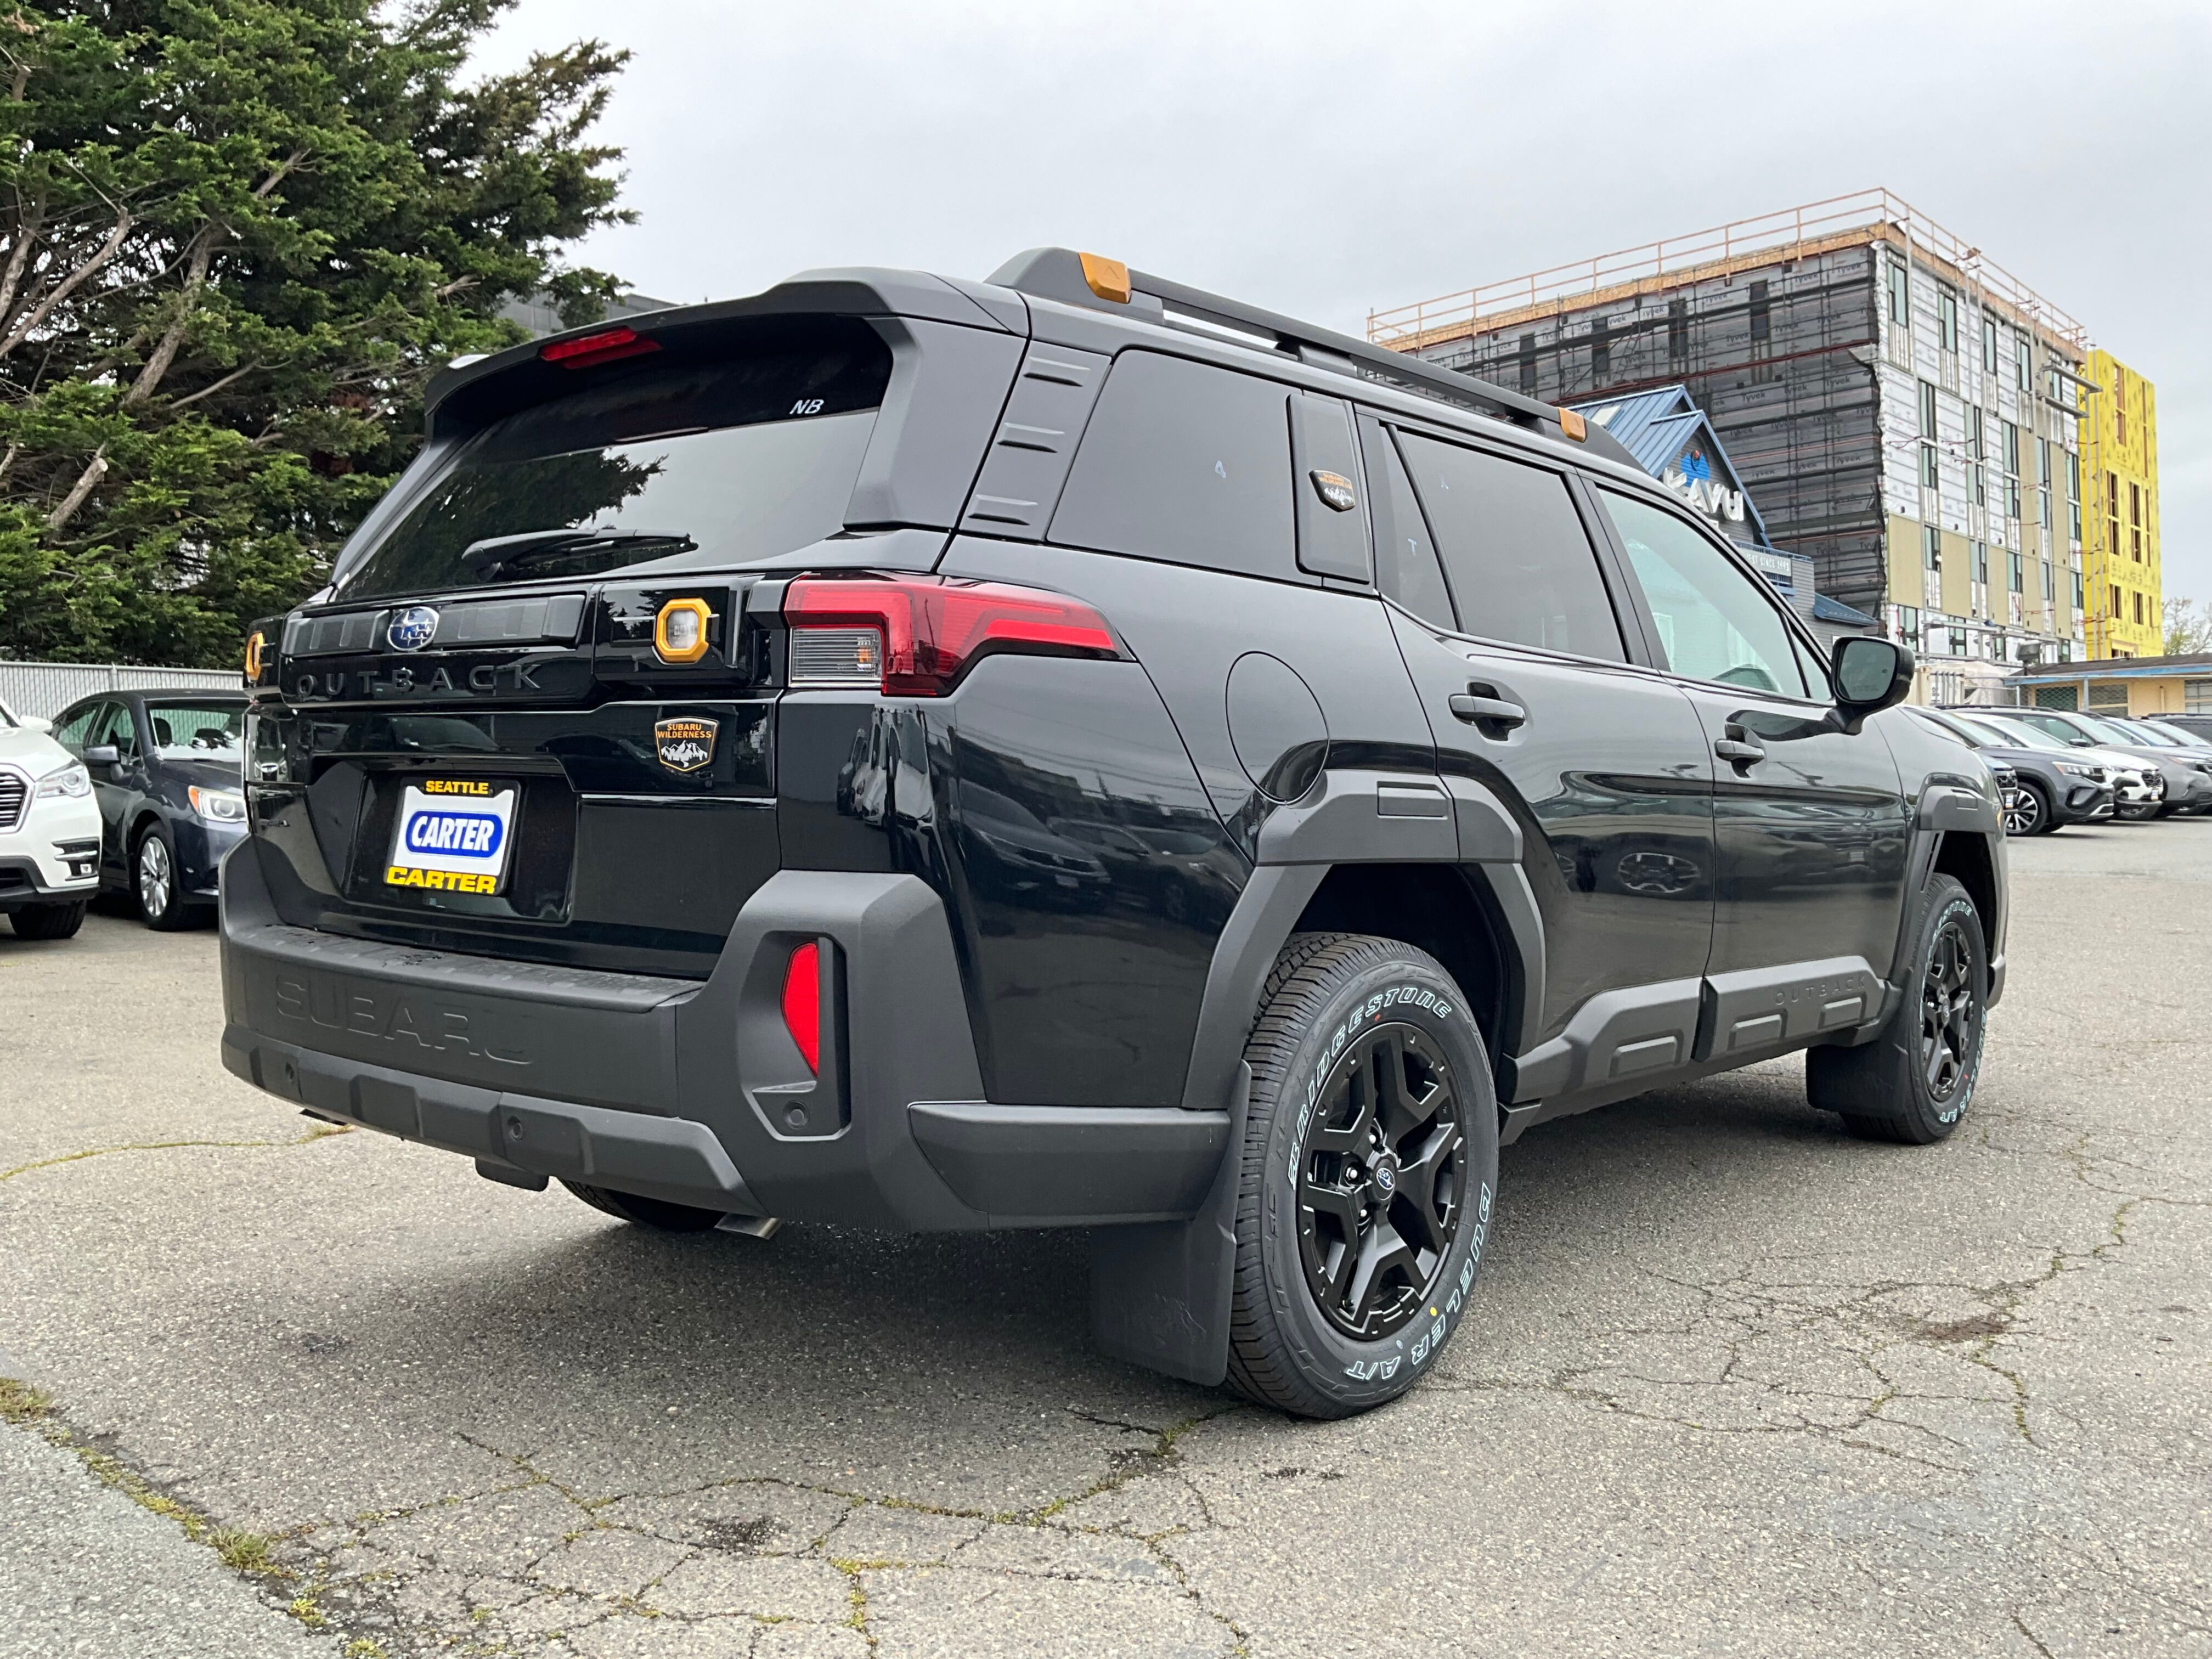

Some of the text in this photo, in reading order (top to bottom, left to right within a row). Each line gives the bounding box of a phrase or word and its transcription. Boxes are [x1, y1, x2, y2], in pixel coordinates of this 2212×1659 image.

[1609, 314, 1626, 325] yvek
[1826, 376, 1851, 387] Tyvek
[789, 399, 824, 414] NB
[1742, 391, 1765, 402] Tyvek
[297, 664, 541, 697] OUTBACK
[426, 780, 489, 795] SEATTLE
[411, 816, 495, 851] CARTER
[387, 866, 496, 894] CARTER
[1774, 975, 1866, 1006] OUTBACK
[1288, 987, 1452, 1190] BRIDGESTONE
[1346, 1181, 1491, 1380] DUELER A/T
